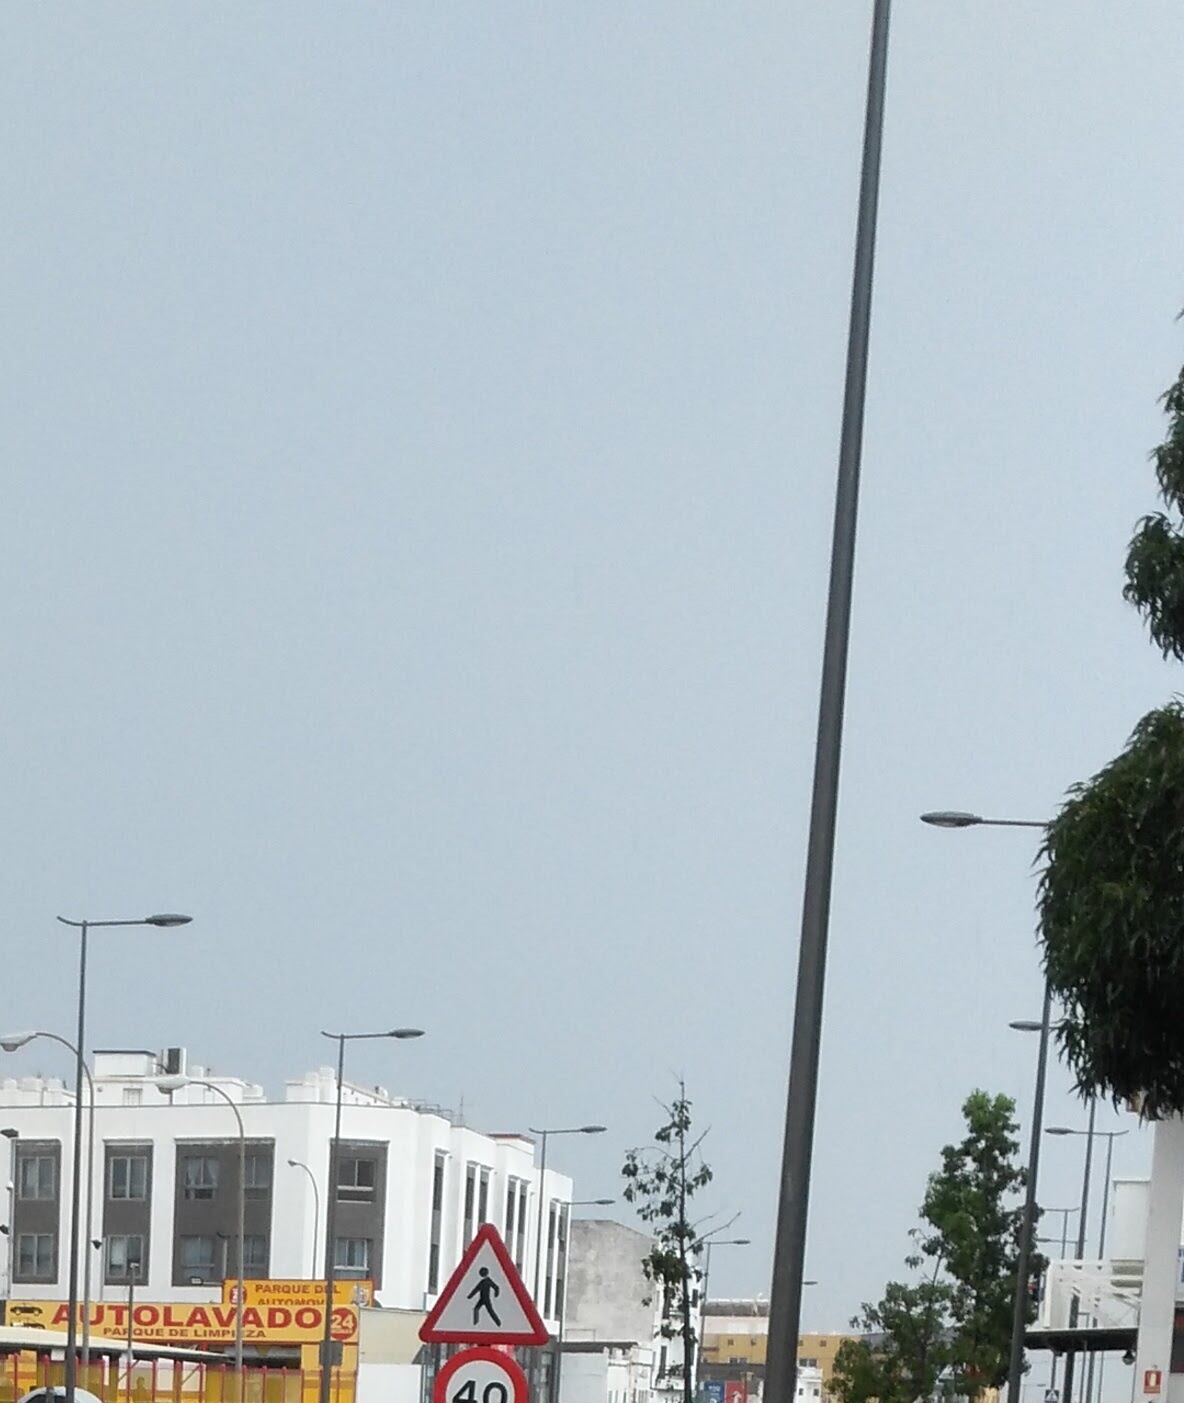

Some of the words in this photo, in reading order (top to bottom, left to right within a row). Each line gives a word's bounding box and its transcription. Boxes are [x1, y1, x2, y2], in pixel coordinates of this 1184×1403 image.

[255, 1284, 310, 1294] PARQUE
[315, 1285, 341, 1295] DL
[51, 1303, 323, 1330] AUTOLAVADO
[331, 1313, 354, 1330] 24
[169, 1328, 188, 1338] DE
[194, 1328, 266, 1338] LIMPIZA
